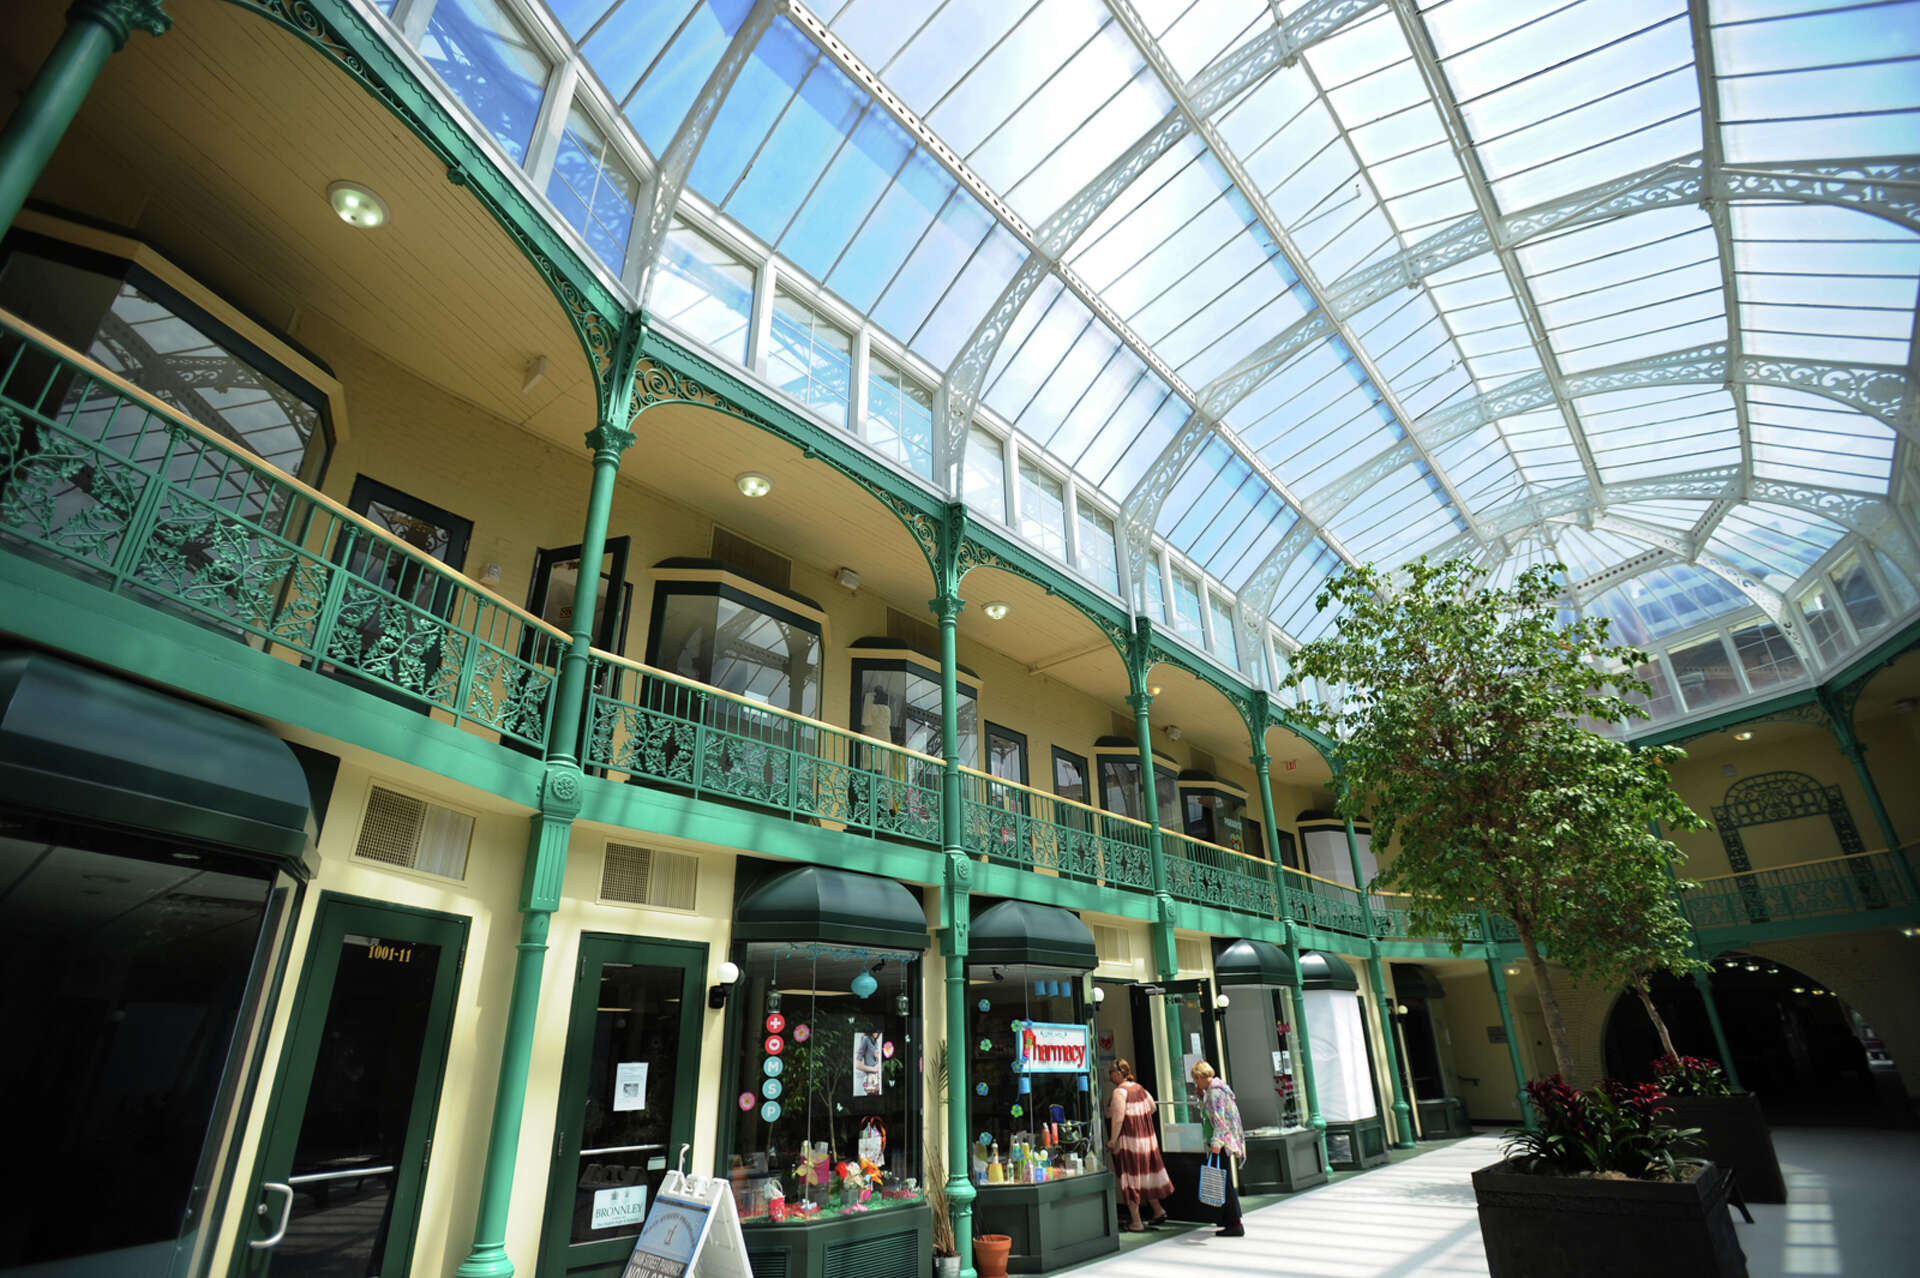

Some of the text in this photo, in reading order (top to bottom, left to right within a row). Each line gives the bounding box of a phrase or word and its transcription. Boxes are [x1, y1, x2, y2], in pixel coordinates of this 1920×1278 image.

[368, 945, 411, 962] 1001-11
[1022, 1029, 1086, 1068] Pharmacy
[595, 1204, 642, 1218] BRONNLEY
